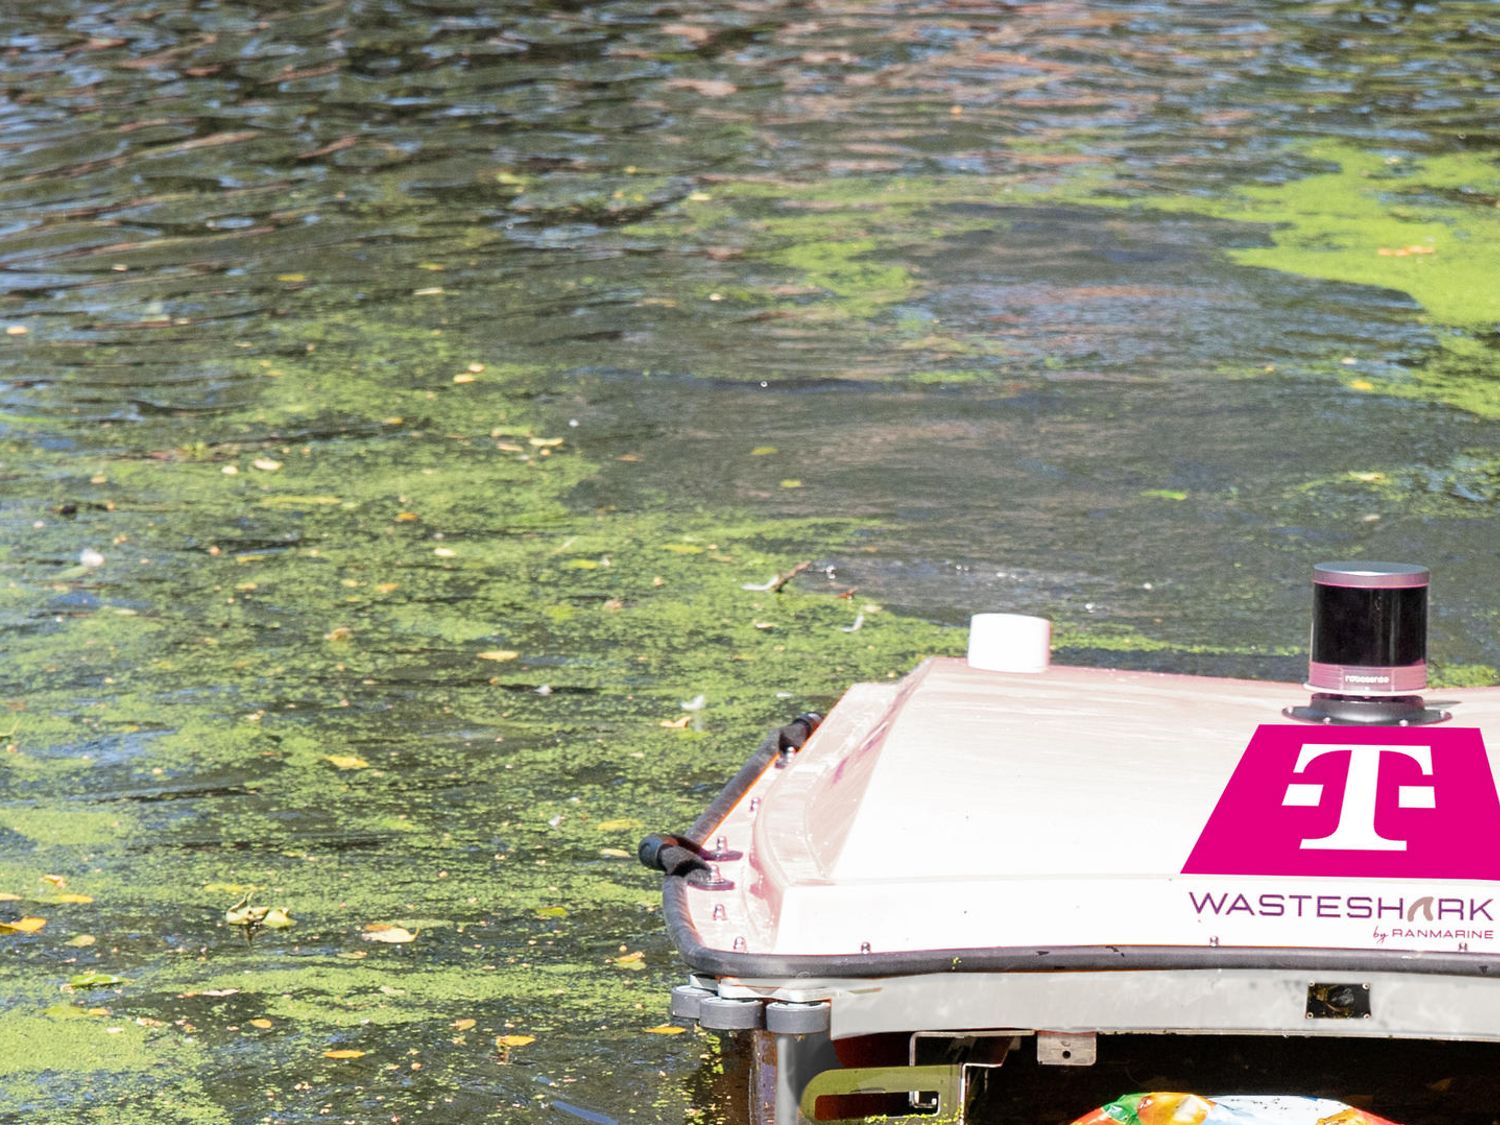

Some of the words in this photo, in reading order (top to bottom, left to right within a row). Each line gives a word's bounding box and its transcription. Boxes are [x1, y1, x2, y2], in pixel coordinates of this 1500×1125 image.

[1281, 743, 1437, 851] T
[1189, 891, 1495, 922] WASTESHARK
[1373, 926, 1389, 944] by
[1392, 928, 1495, 940] RANMARINE
